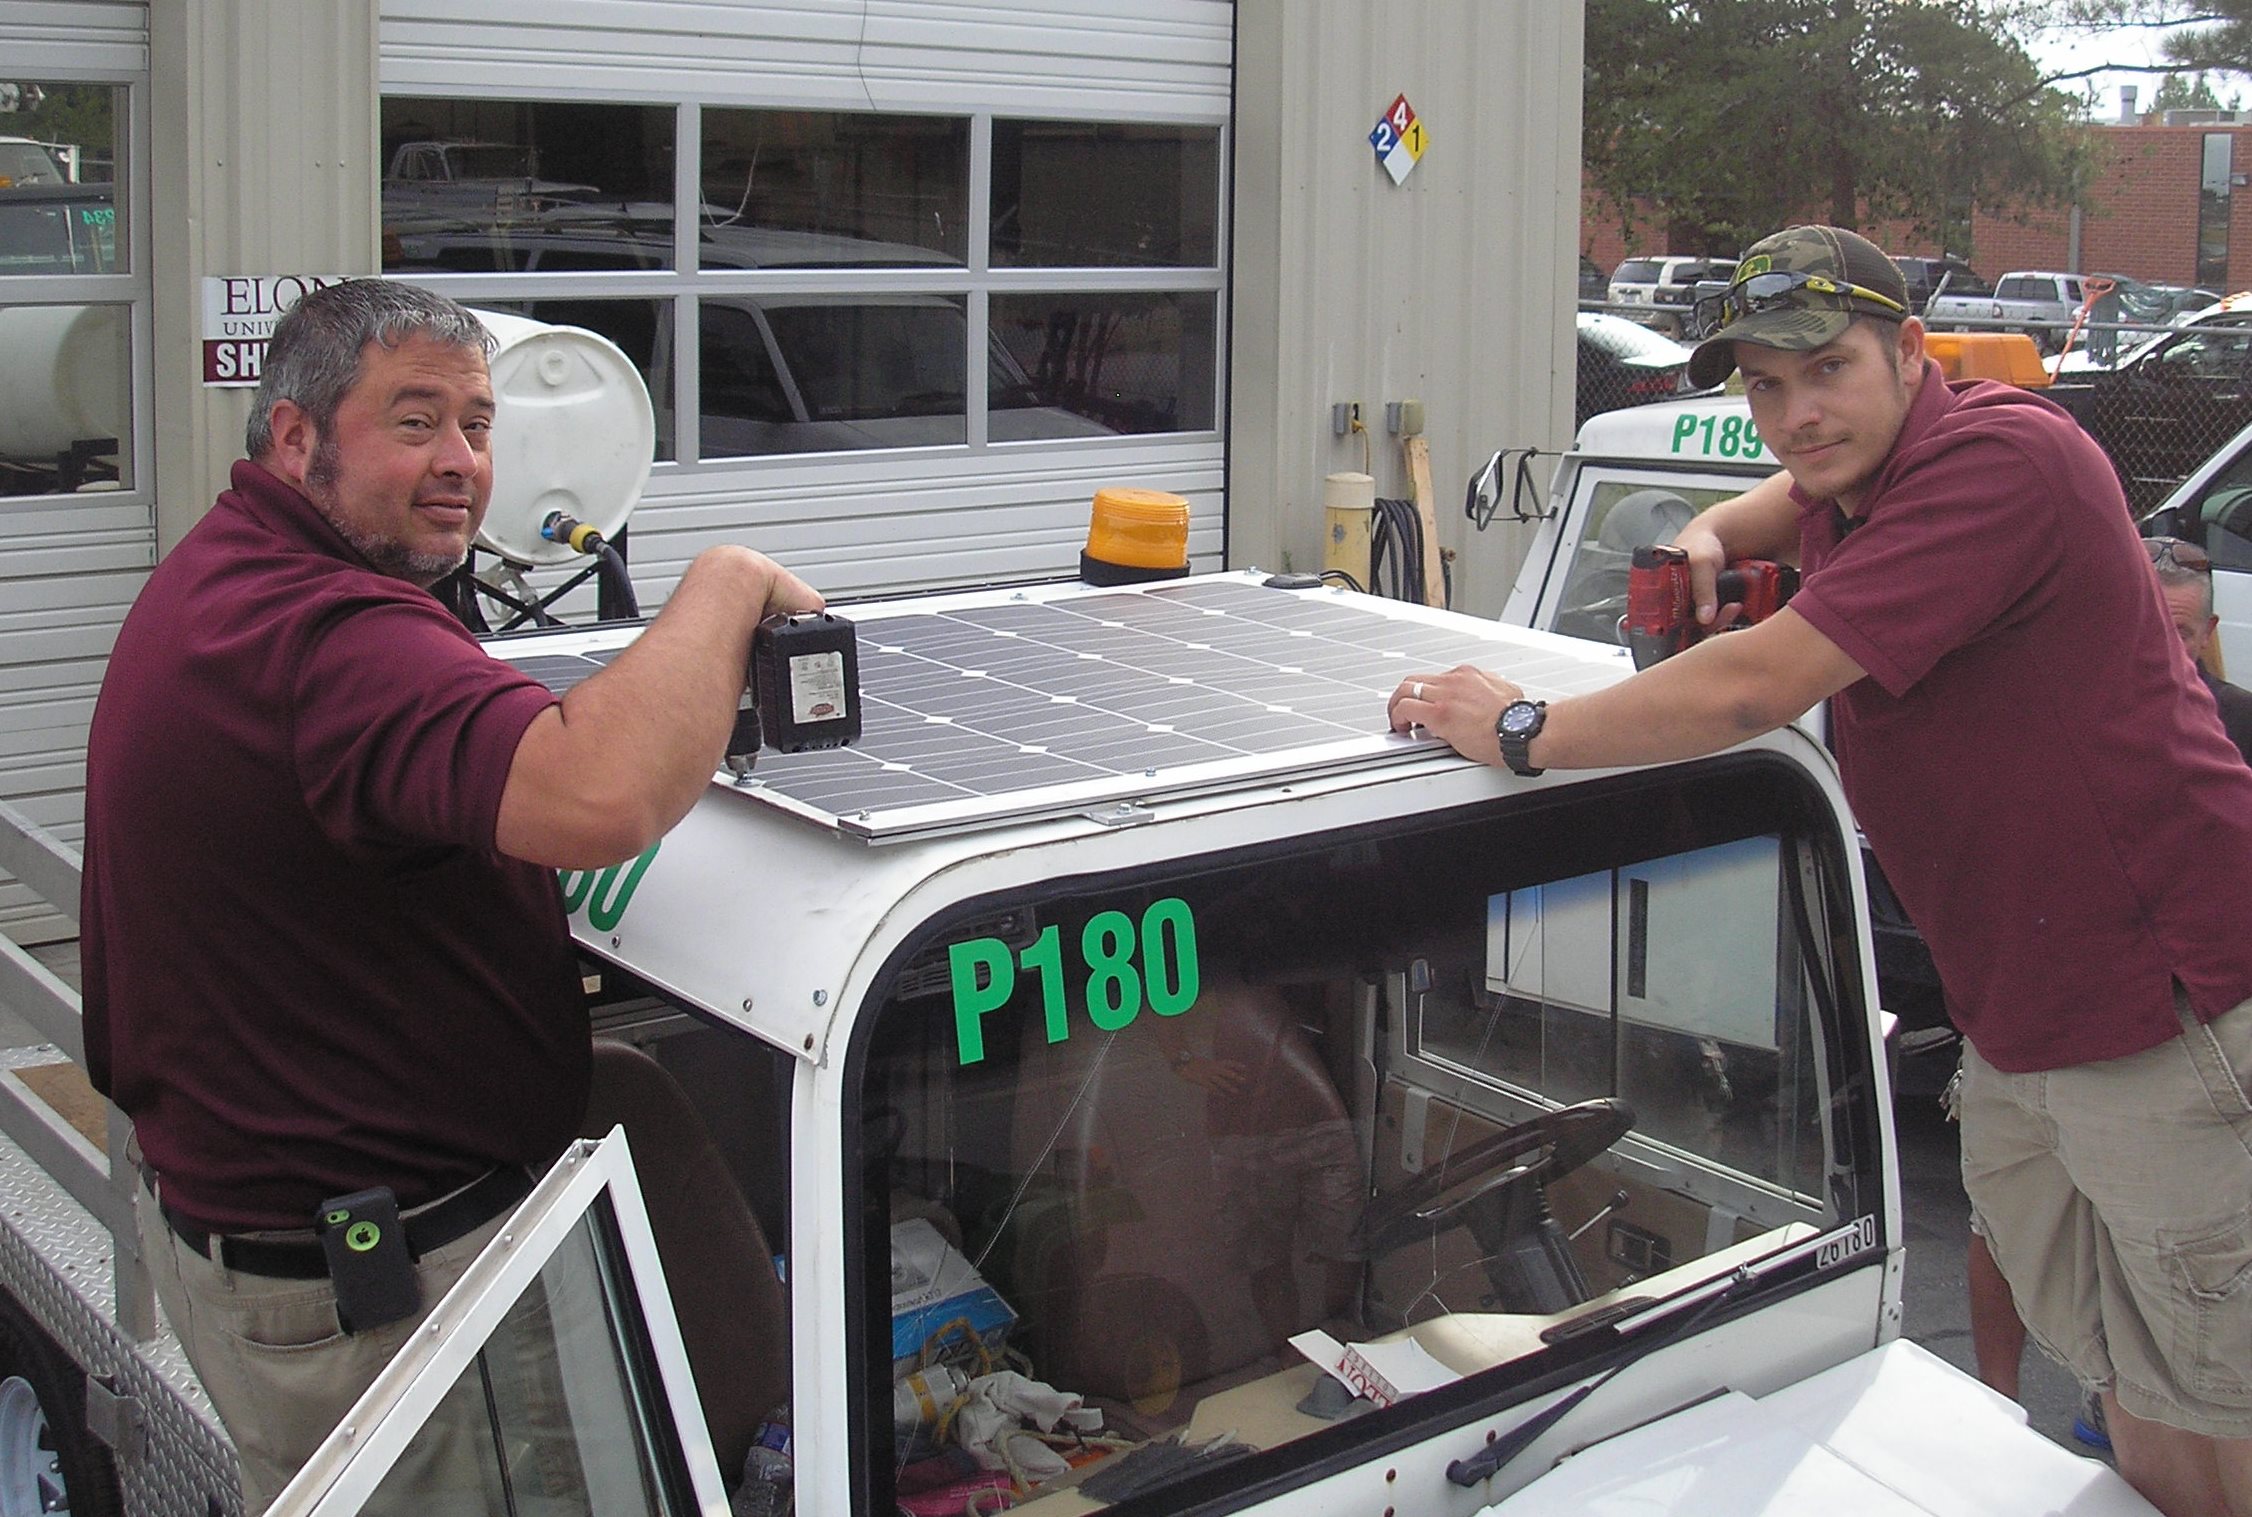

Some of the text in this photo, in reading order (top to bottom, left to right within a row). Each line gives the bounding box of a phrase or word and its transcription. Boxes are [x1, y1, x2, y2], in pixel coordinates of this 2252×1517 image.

[1392, 101, 1408, 132] 4
[1376, 122, 1420, 152] 2 1
[216, 342, 269, 378] SH
[1672, 414, 1764, 459] P189
[949, 898, 1200, 1066] P180
